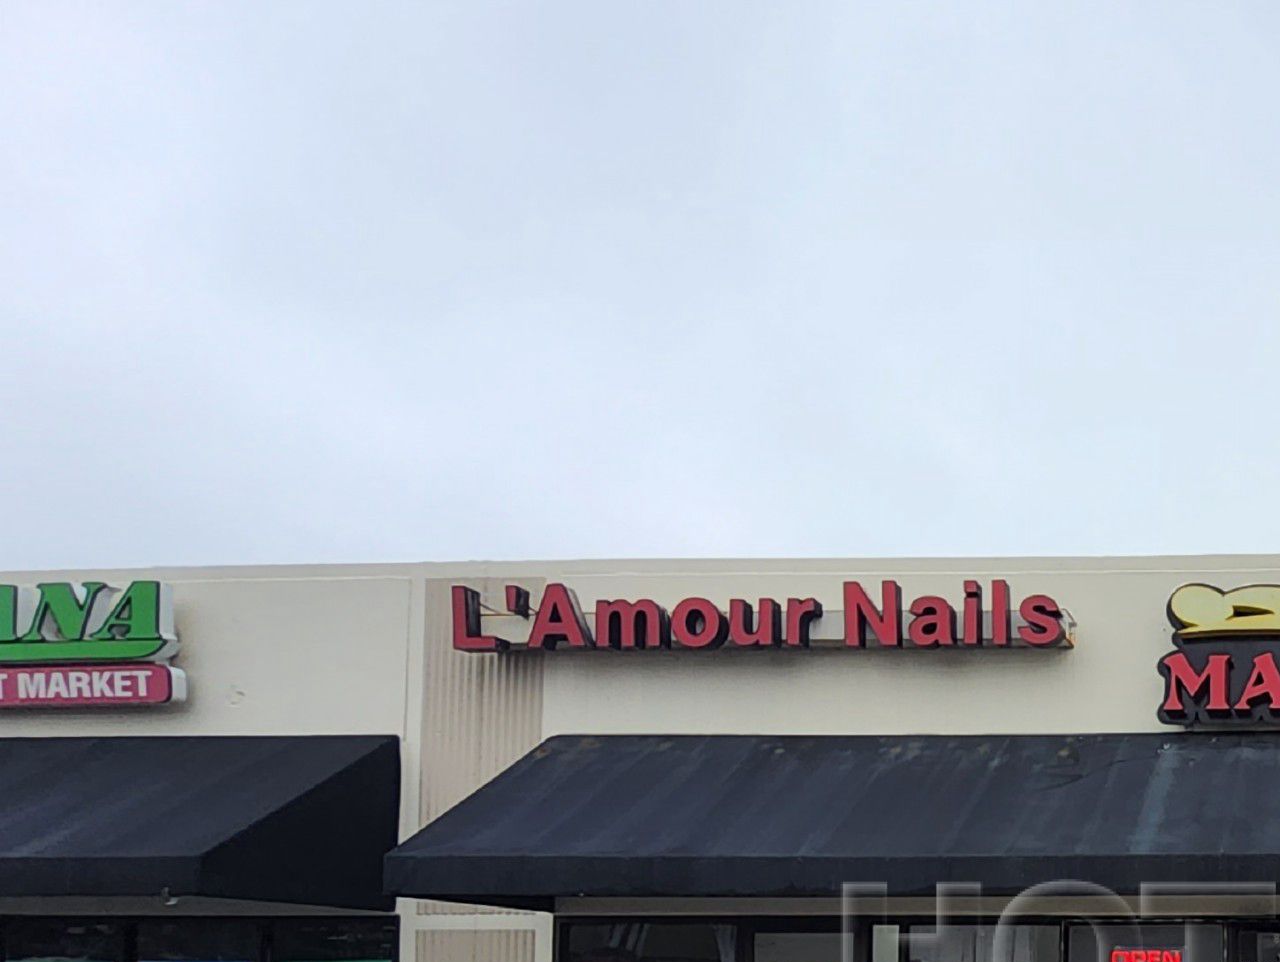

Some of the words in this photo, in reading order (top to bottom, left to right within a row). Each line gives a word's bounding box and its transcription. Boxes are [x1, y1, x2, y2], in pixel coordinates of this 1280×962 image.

[451, 583, 818, 651] L'Amour
[843, 579, 1065, 647] Nails
[16, 671, 153, 699] MARKET
